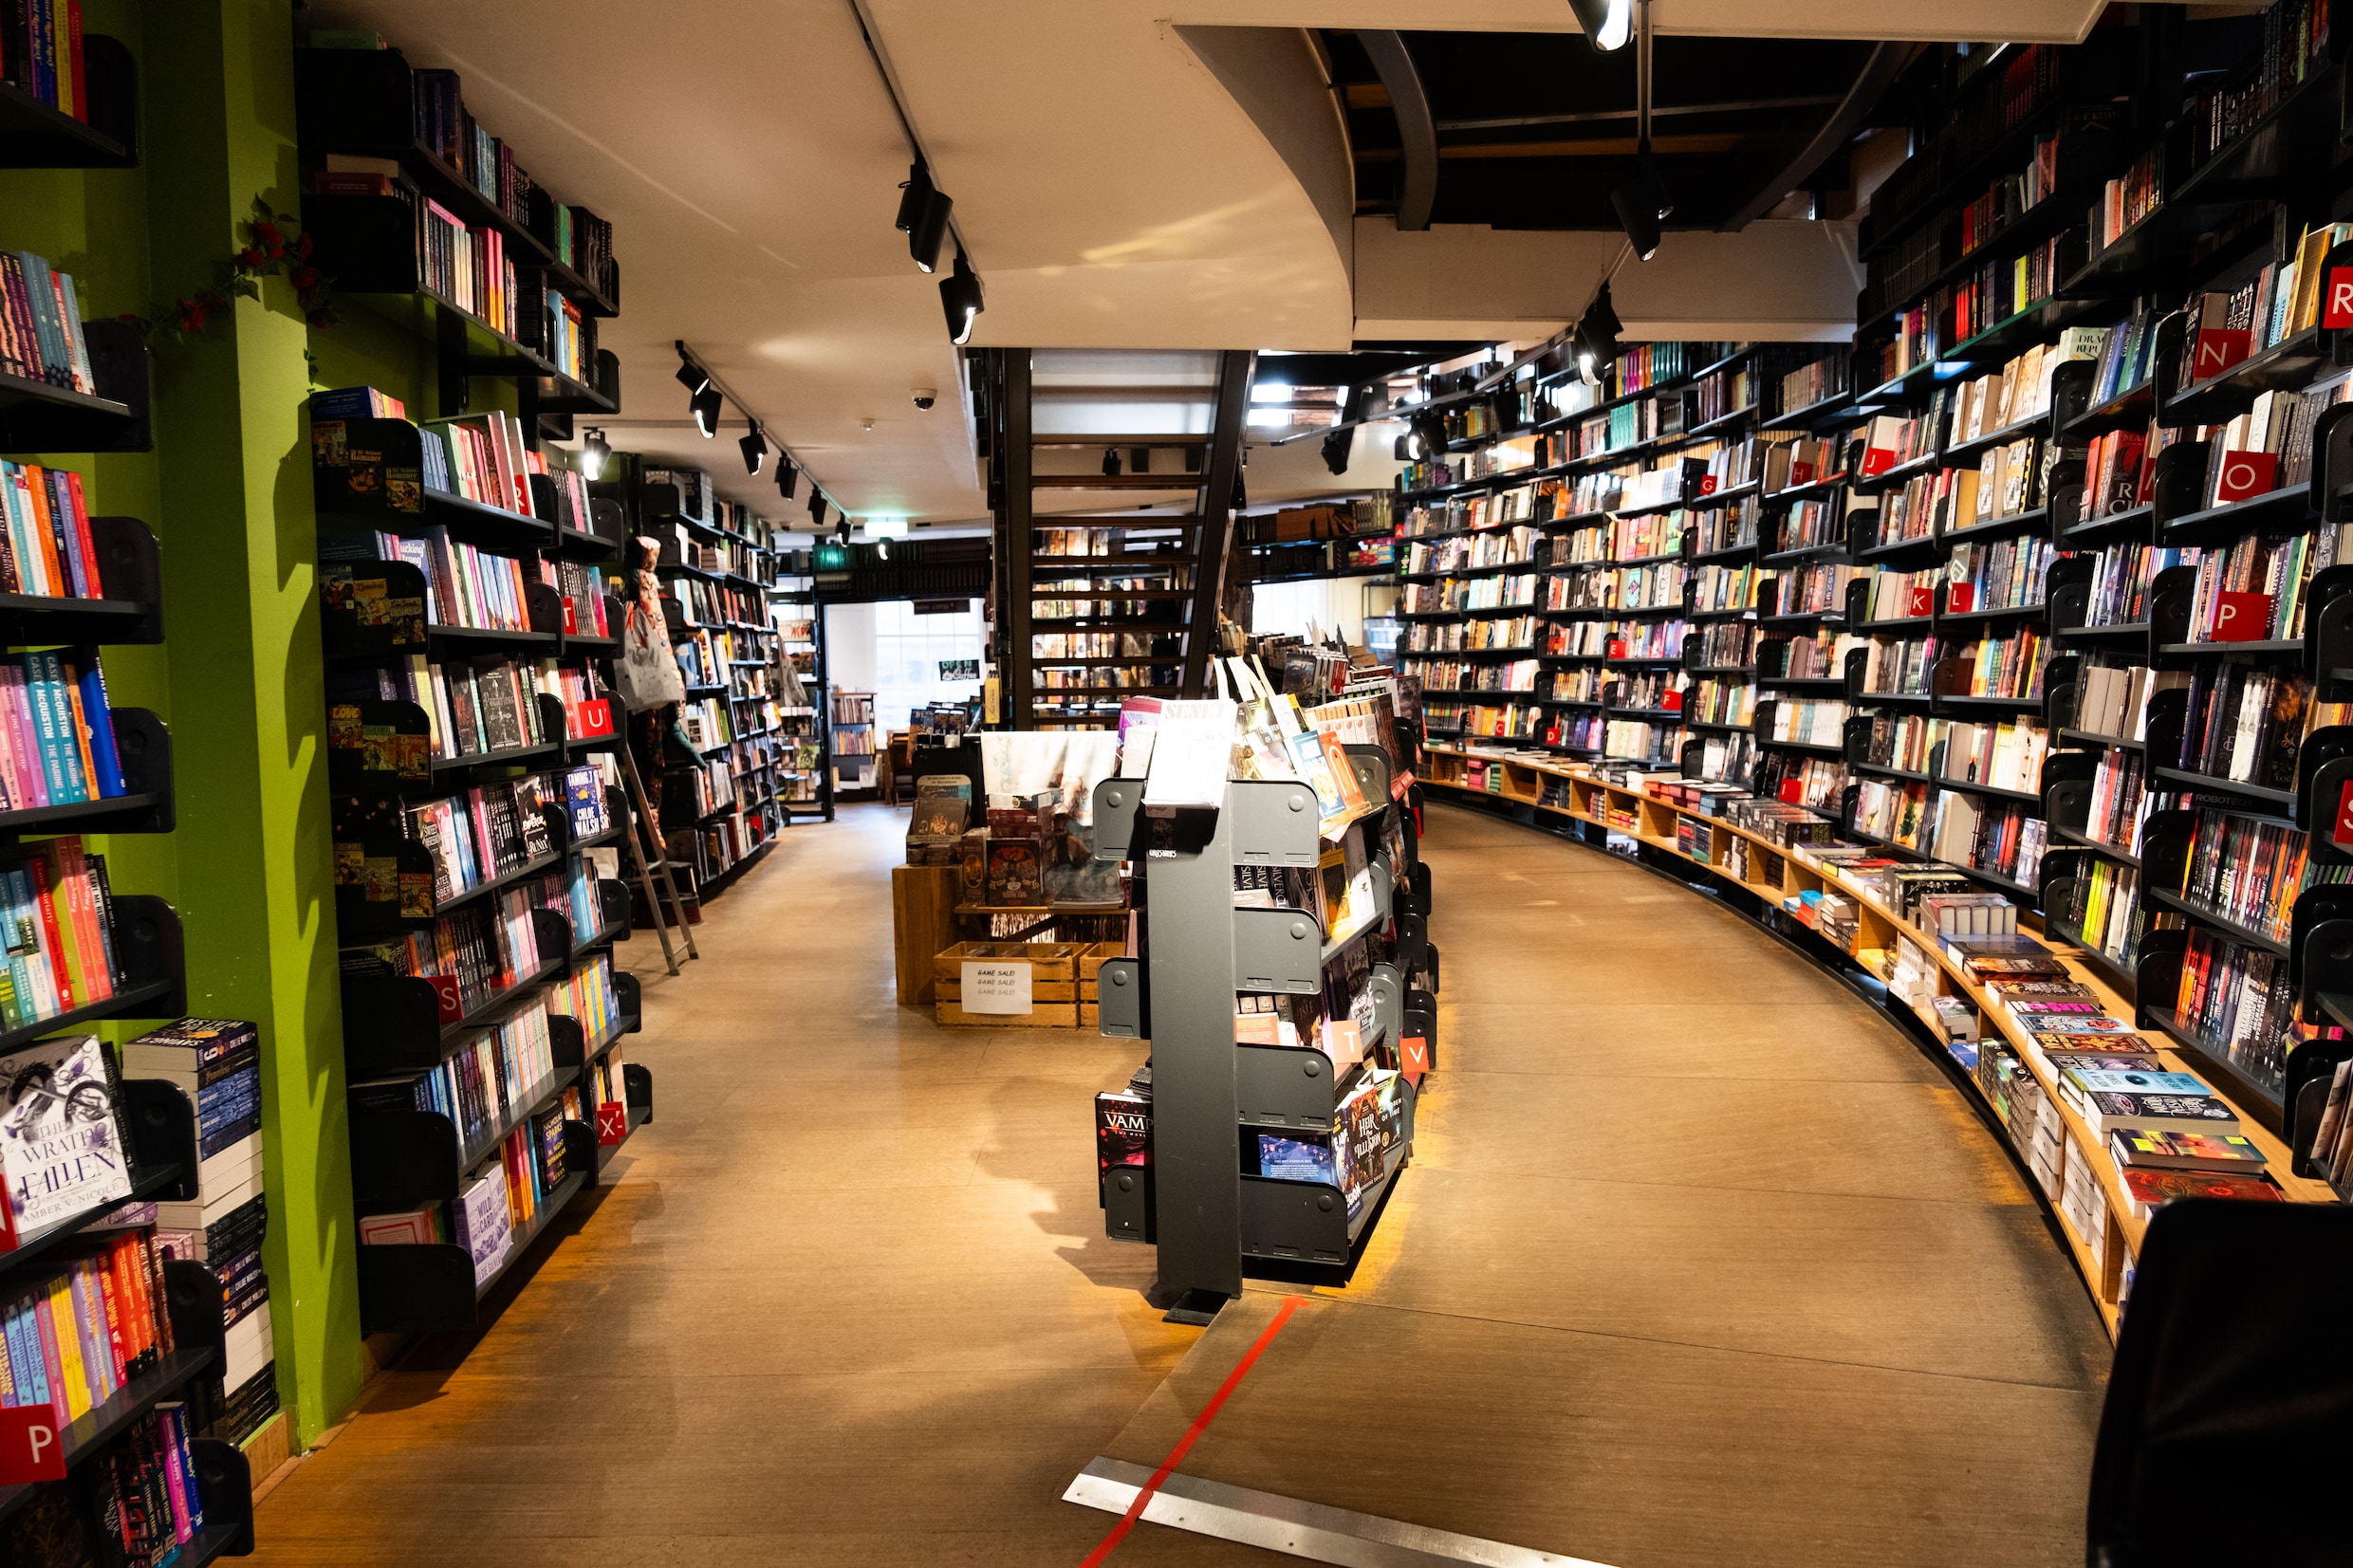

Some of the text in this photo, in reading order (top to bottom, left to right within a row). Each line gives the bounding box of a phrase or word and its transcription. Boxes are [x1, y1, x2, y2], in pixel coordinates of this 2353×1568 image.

[2332, 283, 2353, 314] R
[54, 286, 72, 342] THE GETAWAY
[2199, 341, 2228, 367] N
[1866, 453, 1877, 470] J
[1702, 478, 1714, 492] G
[1792, 469, 1804, 481] H
[2225, 464, 2256, 490] O
[46, 480, 65, 537] HAD Hello
[65, 510, 74, 531] Never
[69, 532, 78, 547] Met
[1912, 594, 1924, 611] K
[1952, 590, 1960, 607] L
[563, 606, 572, 627] T
[2215, 604, 2237, 630] P
[1609, 644, 1618, 656] E
[941, 660, 973, 670] OPEN
[953, 667, 978, 680] Coffee
[19, 689, 30, 720] McQUISTON
[102, 692, 111, 710] TRAP
[1164, 703, 1228, 720] SENET
[1663, 694, 1670, 706] F
[10, 714, 19, 731] ONE
[30, 656, 64, 789] CASEY McQUISTON THE PAIRING
[46, 656, 81, 787] CASEY McQUISTON THE PAIRING
[332, 707, 360, 719] LOVE
[587, 708, 604, 729] U
[1495, 722, 1504, 732] C
[1547, 730, 1555, 741] D
[13, 731, 23, 752] LAST
[17, 752, 28, 772] STOP
[567, 771, 589, 786] TAMING
[2195, 793, 2252, 806] ROBOTECH
[576, 806, 596, 821] CHLOE
[574, 817, 601, 838] WALSH
[89, 873, 100, 894] LEAVE
[97, 906, 105, 931] BEHIND
[5, 902, 17, 943] MORIARTY
[22, 905, 34, 946] MORIARTY
[35, 861, 46, 886] Liane
[41, 888, 54, 924] Moriarty
[48, 931, 60, 953] Apples
[54, 953, 64, 972] Never
[14, 963, 27, 1001] STRANGERS
[22, 973, 31, 1003] PERFECT
[440, 987, 458, 1011] S
[2254, 996, 2268, 1042] FIDDLEHEAD
[1343, 1030, 1358, 1054] T
[203, 1048, 219, 1061] 6
[1408, 1045, 1424, 1064] V
[599, 1116, 616, 1137] X
[1359, 1113, 1380, 1138] HEIR
[1354, 1131, 1381, 1160] ILLUSION
[21, 1151, 116, 1201] FALLEN
[22, 1205, 62, 1224] AMBER
[78, 1182, 120, 1203] NICOLE
[110, 1202, 144, 1224] BOYFRIEND
[476, 1196, 492, 1218] WILD
[479, 1212, 494, 1234] CARD
[476, 1255, 502, 1282] ELSIE SILVER
[101, 1270, 114, 1297] WRONG
[104, 1297, 120, 1330] NUMBER
[14, 1328, 30, 1388] NOTHING LIKE
[25, 1326, 39, 1378] THE MOVIES
[30, 1319, 46, 1378] NOTHING LIKE
[83, 1318, 94, 1333] AMY
[90, 1356, 101, 1387] PAINTER
[9, 1336, 24, 1389] THE MOVIES
[113, 1348, 122, 1374] PAINTER
[28, 1425, 52, 1465] P
[166, 1416, 182, 1482] Sounds Like Love
[157, 1470, 168, 1502] STEPHANIE
[163, 1502, 173, 1525] PERKINS
[106, 1496, 120, 1538] NEVER
